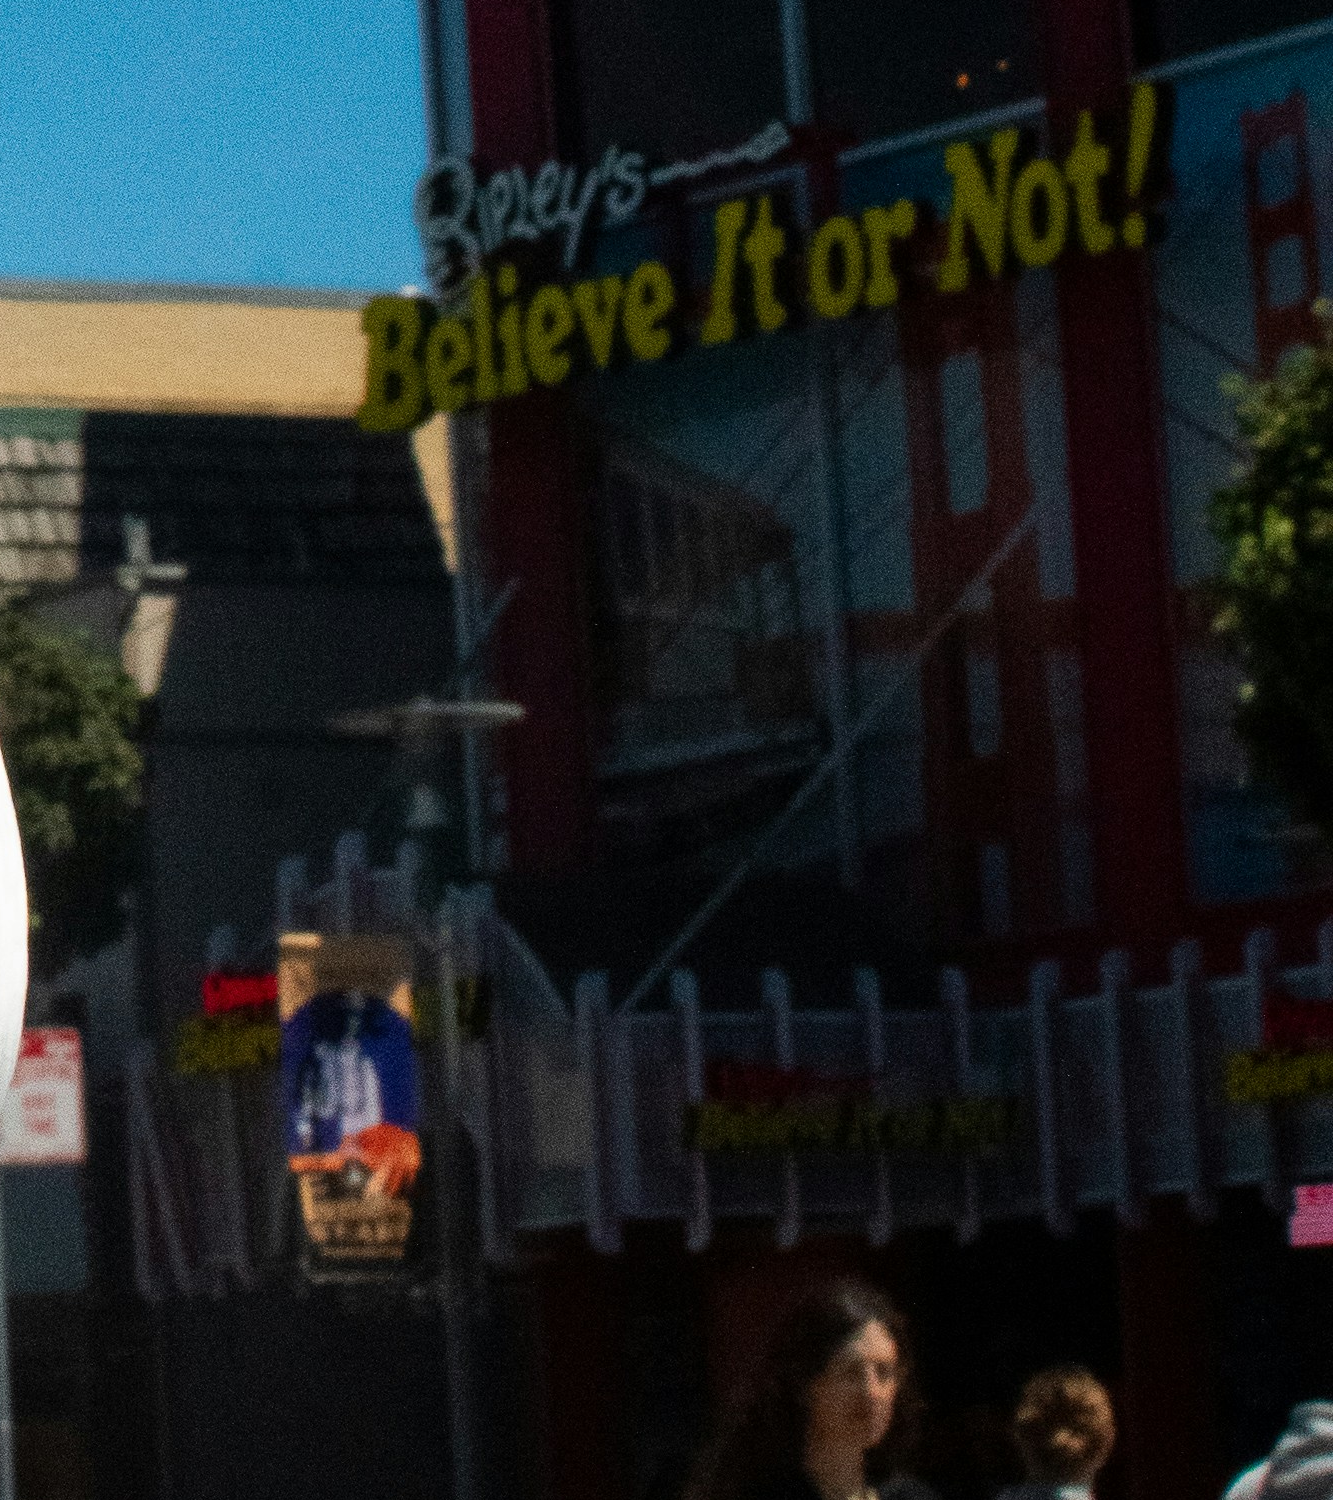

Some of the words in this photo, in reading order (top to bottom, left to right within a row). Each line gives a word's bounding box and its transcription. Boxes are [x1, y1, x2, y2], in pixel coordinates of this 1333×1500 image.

[356, 260, 675, 432] Believe
[700, 196, 787, 346] It
[809, 198, 917, 318] or
[936, 80, 1157, 293] Not!
